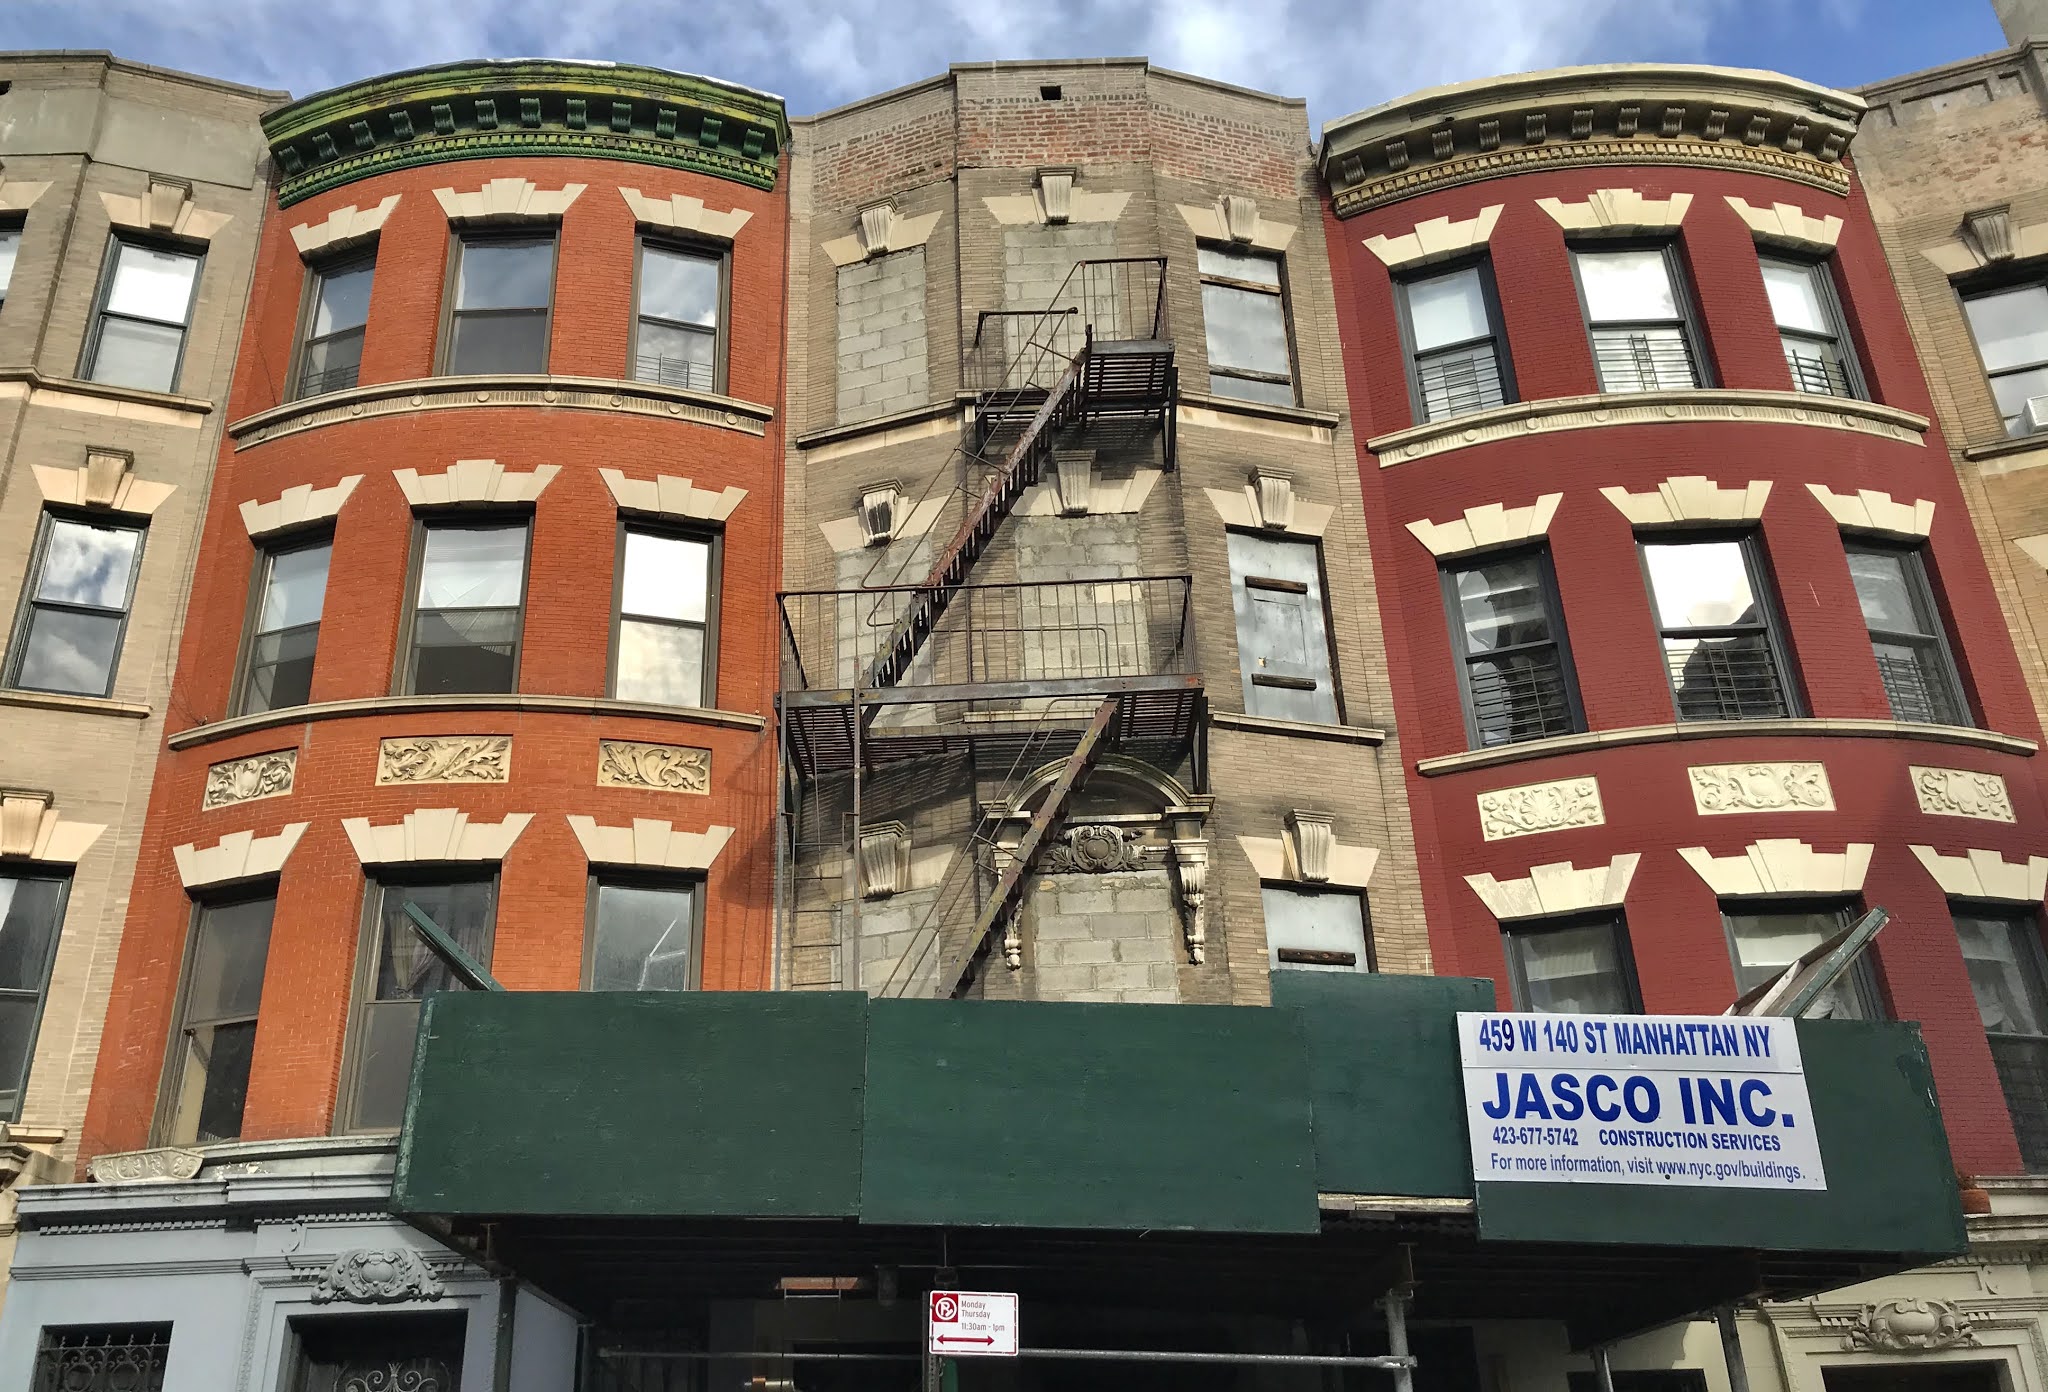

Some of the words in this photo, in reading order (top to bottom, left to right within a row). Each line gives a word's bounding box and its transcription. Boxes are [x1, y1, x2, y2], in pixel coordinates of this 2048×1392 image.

[1479, 1019, 1515, 1052] 459
[1518, 1020, 1537, 1052] W
[1543, 1021, 1578, 1052] 140
[1585, 1022, 1608, 1054] ST
[1614, 1023, 1738, 1057] MANHATTAN
[1742, 1026, 1770, 1058] NY
[1482, 1072, 1661, 1123] JASCO
[1678, 1078, 1795, 1128] INC.
[1492, 1126, 1578, 1146] 423-677-5742
[1599, 1130, 1708, 1149] CONSTRUCTION
[1712, 1134, 1781, 1151] SERVICES
[1491, 1153, 1512, 1170] For
[1515, 1157, 1547, 1171] more
[1550, 1154, 1625, 1175] information,
[1627, 1159, 1654, 1174] visit
[1656, 1160, 1806, 1183] www.nyc.gov/buildings.
[961, 1300, 986, 1310] Monday
[961, 1310, 991, 1319] Thursday
[961, 1322, 987, 1331] 11:30am
[992, 1323, 1005, 1332] 1pm
